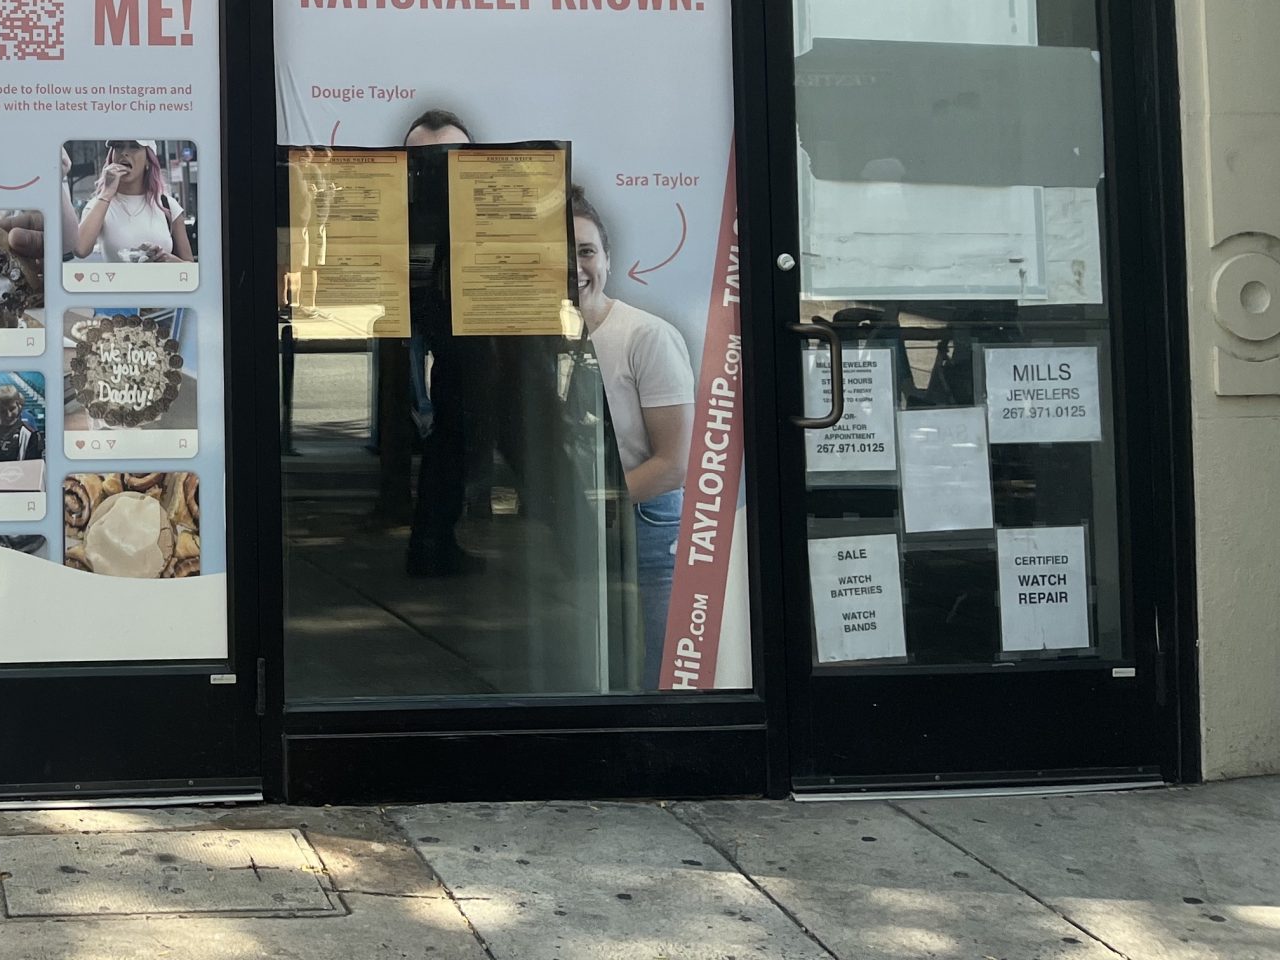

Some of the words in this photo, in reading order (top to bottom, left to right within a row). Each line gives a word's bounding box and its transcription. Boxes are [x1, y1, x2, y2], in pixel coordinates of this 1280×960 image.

[21, 85, 33, 95] to
[36, 84, 71, 95] follow
[75, 86, 88, 95] us
[91, 86, 106, 95] on
[109, 84, 167, 97] Instagram
[170, 84, 192, 95] and
[311, 85, 364, 102] Dougie
[368, 84, 416, 103] Taylor
[4, 101, 30, 111] with
[33, 101, 53, 111] the
[55, 100, 88, 111] latest
[91, 100, 127, 113] Taylor
[129, 100, 156, 113] Chip
[159, 101, 193, 111] news!
[615, 173, 649, 186] Sara
[653, 173, 700, 190] Taylor
[101, 342, 121, 362] We
[127, 343, 157, 366] love
[111, 364, 140, 383] you
[1013, 363, 1071, 381] MILLS
[98, 381, 154, 411] Daddy!
[1006, 387, 1080, 401] JEWELERS
[1002, 405, 1086, 419] 267.971.0125
[816, 443, 885, 453] 267.971.0125
[837, 549, 868, 560] SALE
[1014, 555, 1069, 565] CERTIFIED
[838, 574, 872, 585] WATCH
[1018, 573, 1067, 586] WATCH
[830, 585, 883, 598] BATTERIES
[1018, 591, 1068, 604] REPAIR
[842, 610, 876, 621] WATCH
[844, 621, 877, 633] BANDS
